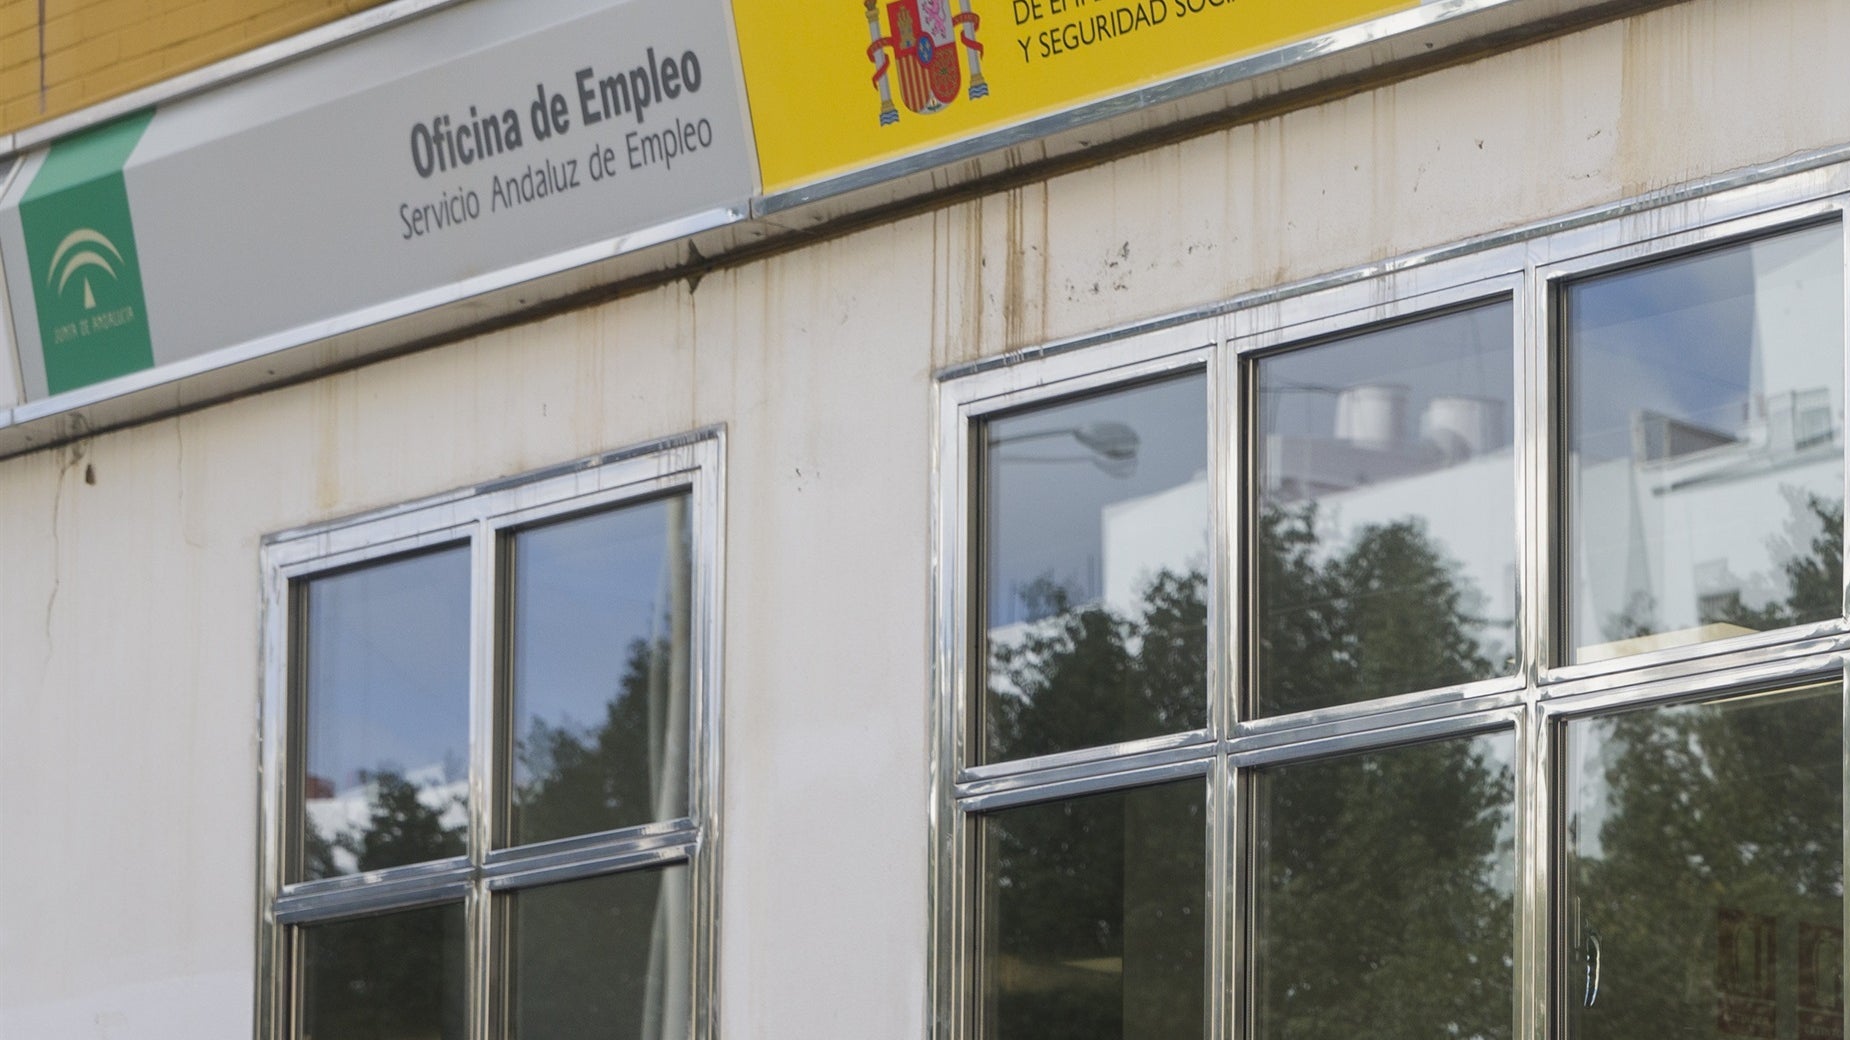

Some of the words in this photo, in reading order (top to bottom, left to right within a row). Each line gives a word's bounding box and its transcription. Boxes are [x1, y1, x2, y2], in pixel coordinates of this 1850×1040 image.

[1013, 0, 1043, 25] DE
[1017, 36, 1032, 63] Y
[1038, 0, 1168, 58] SEGURIDAD
[410, 105, 523, 179] Oficina
[530, 83, 570, 142] de
[575, 47, 702, 127] Empleo
[399, 186, 480, 240] Servicio
[490, 158, 581, 213] Andaluz
[588, 143, 616, 182] de
[625, 116, 713, 171] Empleo
